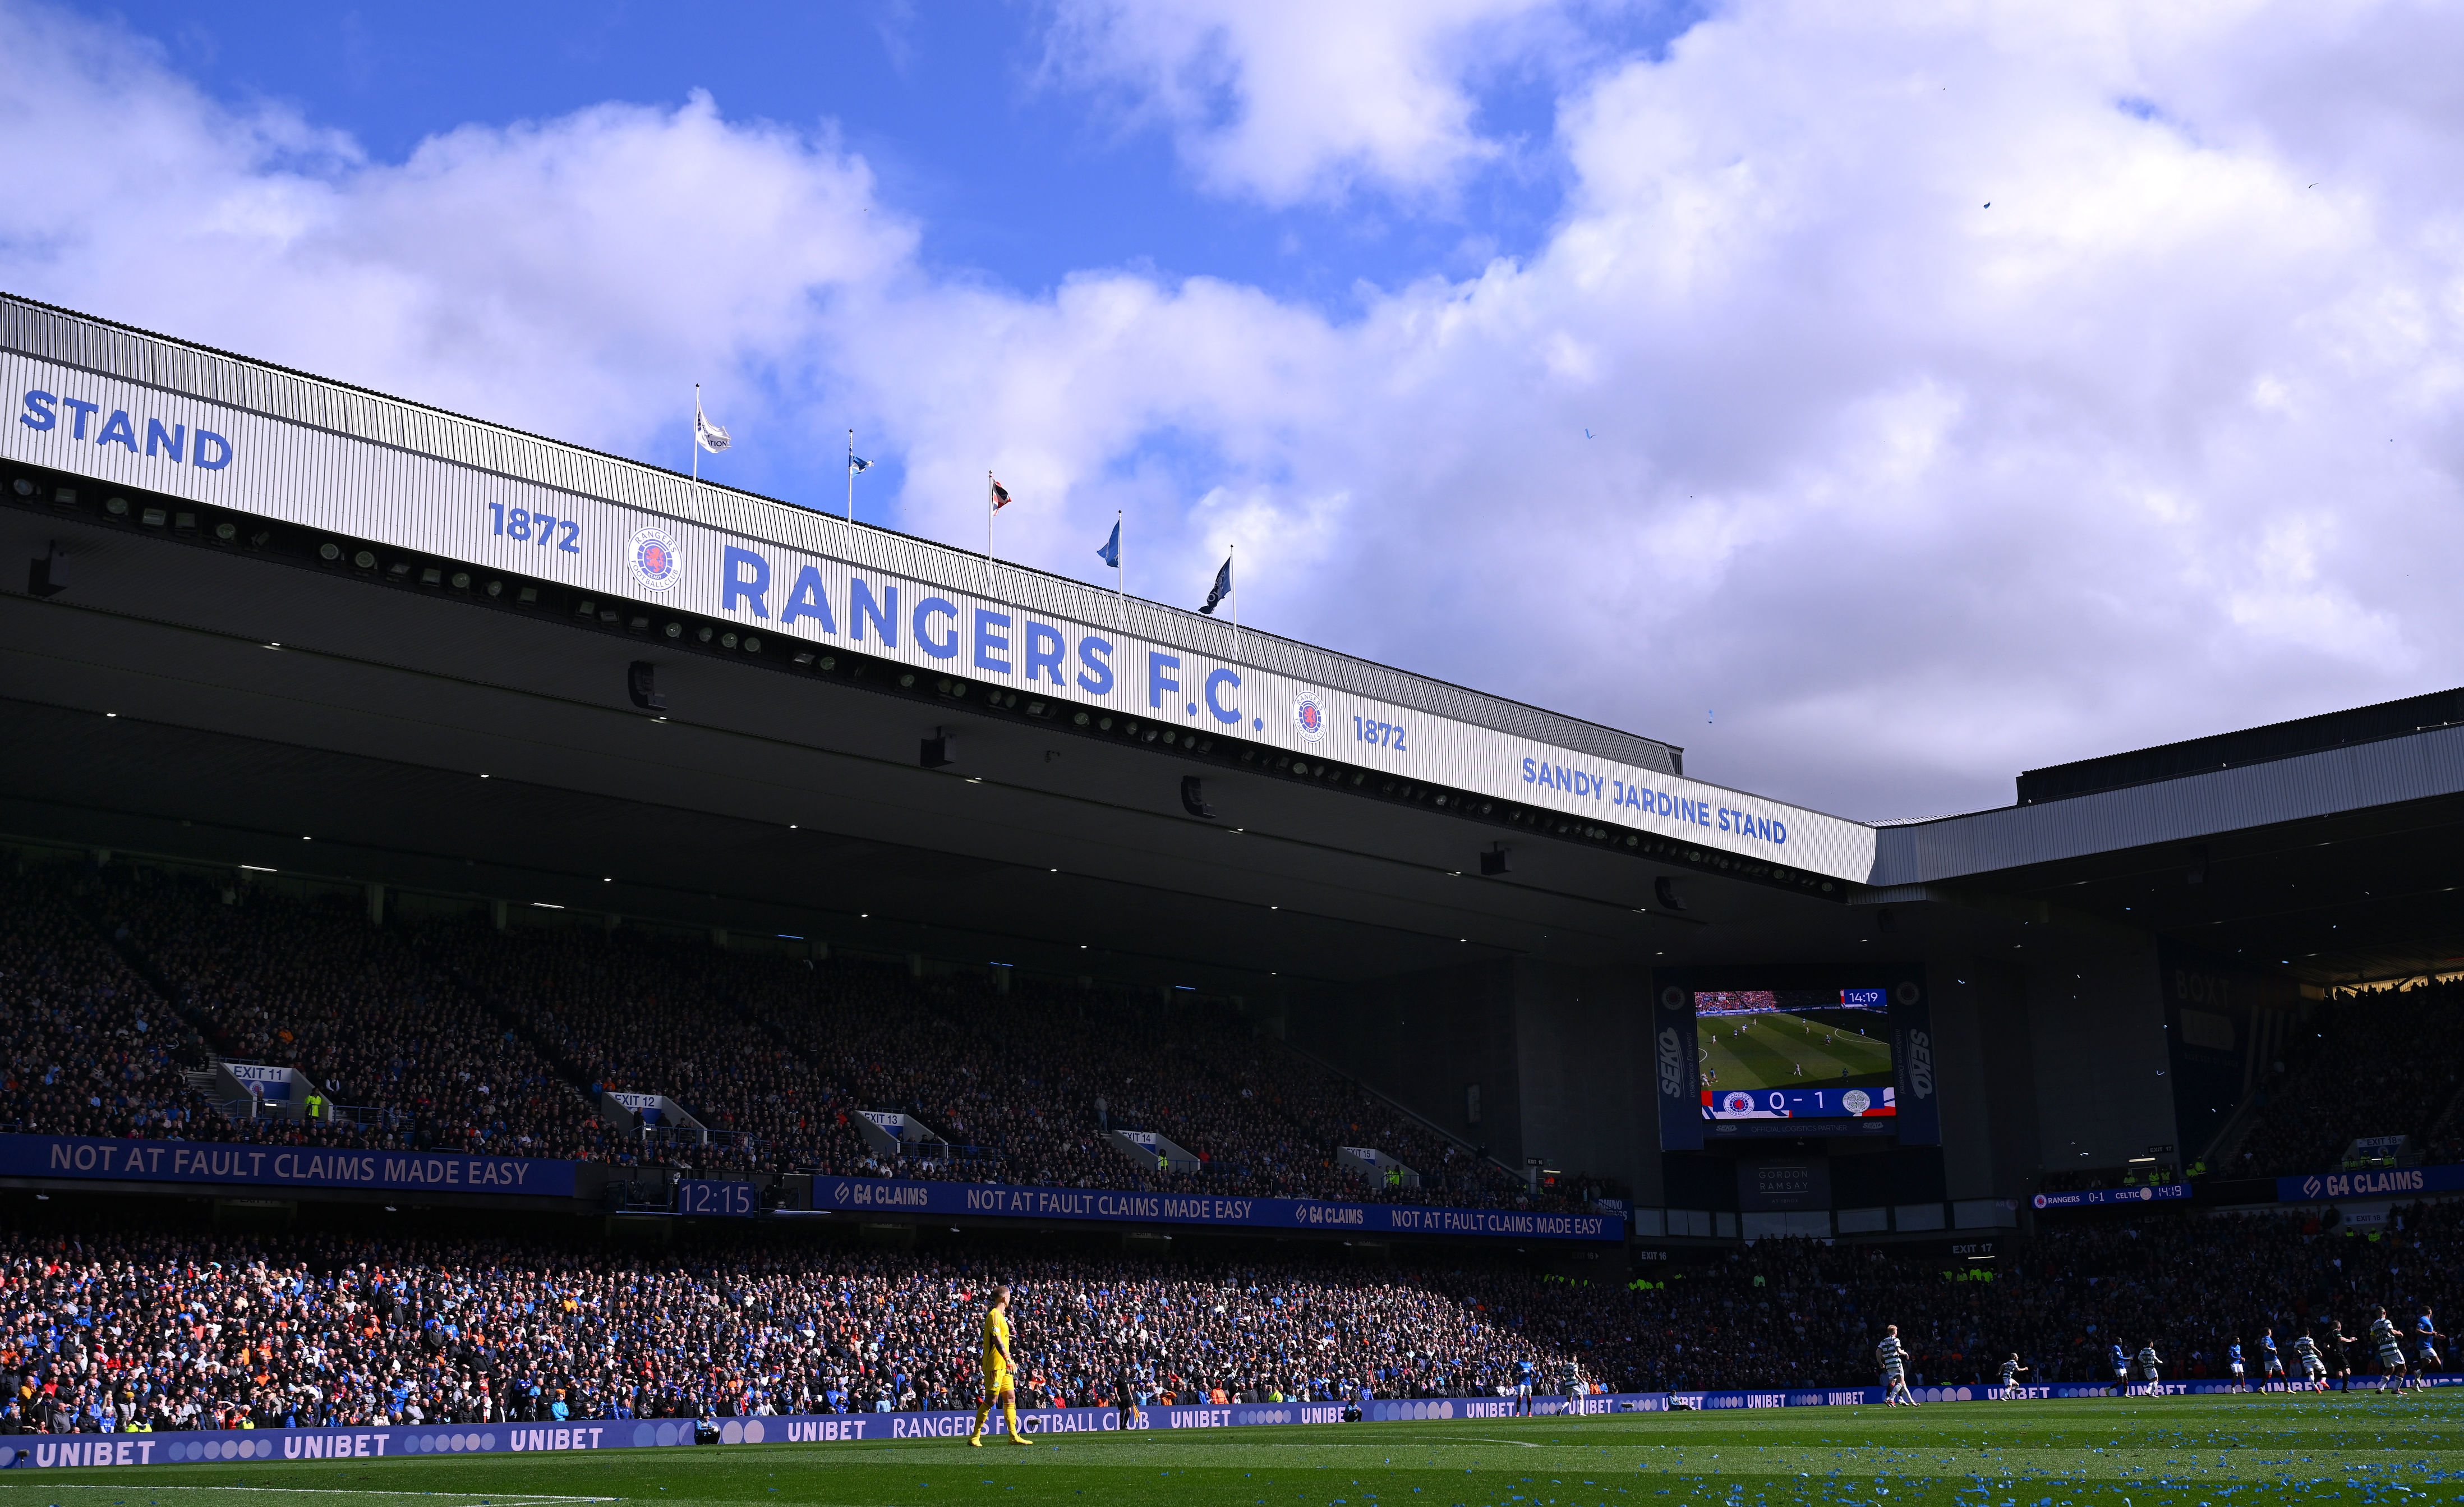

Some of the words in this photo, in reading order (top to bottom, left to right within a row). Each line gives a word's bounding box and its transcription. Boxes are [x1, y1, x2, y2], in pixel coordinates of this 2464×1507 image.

[20, 390, 233, 470] STAND
[489, 502, 580, 554] 1872
[635, 531, 677, 553] RANGERS
[631, 560, 664, 587] FOOTBALL
[665, 569, 678, 585] CLUB
[722, 545, 1112, 695] RANGERS
[1149, 651, 1263, 731] F.C.
[1297, 694, 1323, 711] RANGERS
[1295, 718, 1316, 739] FOOTBALL
[1316, 724, 1325, 737] CLUB
[1353, 716, 1406, 751] 1872
[1523, 757, 1604, 800] SANDY
[1613, 780, 1710, 827] JARDINE
[1718, 807, 1786, 844] STAND
[1850, 992, 1878, 1002] 14:19
[234, 1065, 265, 1079] EXIT
[269, 1069, 282, 1080] 11
[1659, 1027, 1681, 1098] SEKO
[1910, 1028, 1933, 1099] SEKO
[615, 1094, 639, 1105] EXIT
[643, 1096, 655, 1107] 12
[1770, 1092, 1784, 1109] 0
[1814, 1091, 1823, 1109] 1
[887, 1115, 897, 1124] 13
[1122, 1132, 1140, 1142] XIT
[1142, 1134, 1150, 1142] 14
[1347, 1148, 1361, 1157] XIT
[50, 1143, 117, 1171] NOT
[125, 1147, 165, 1173] AT
[174, 1149, 266, 1177] FAULT
[274, 1154, 375, 1181] CLAIMS
[384, 1158, 459, 1183] MADE
[468, 1161, 529, 1185] EASY
[1760, 1182, 1808, 1190] RAMSAY
[2327, 1175, 2350, 1196] G4
[2354, 1170, 2424, 1193] CLAIMS
[682, 1184, 749, 1213] 12:15
[854, 1184, 872, 1205] G4
[875, 1186, 928, 1206] CLAIMS
[968, 1189, 1006, 1210] NOT
[1010, 1192, 1034, 1211] AT
[1039, 1193, 1094, 1214] FAULT
[1098, 1196, 1159, 1217] CLAIMS
[1164, 1198, 1210, 1218] MADE
[1215, 1201, 1252, 1219] EASY
[2048, 1196, 2080, 1204] RANGERS
[2089, 1192, 2104, 1202] 0-1
[2158, 1186, 2182, 1197] 14:19
[1310, 1206, 1323, 1224] G4
[1325, 1207, 1364, 1224] CLAIMS
[1392, 1210, 1420, 1228] NOT
[1424, 1211, 1441, 1228] AT
[1444, 1212, 1485, 1230] FAULT
[1488, 1215, 1533, 1233] CLAIMS
[1537, 1217, 1572, 1234] MADE
[1574, 1218, 1602, 1234] EASY
[1641, 1251, 1657, 1260] EXIT
[1659, 1252, 1667, 1260] 16
[1952, 1244, 1977, 1254] EXIT
[1981, 1243, 1992, 1252] 17
[1829, 1391, 1864, 1406] UNIBET
[2127, 1384, 2187, 1396] UNBET
[1466, 1402, 1515, 1418] UNIBET
[1662, 1394, 1703, 1412] UBET
[1747, 1394, 1786, 1409] UNIBET
[1171, 1409, 1231, 1428] UNIBET
[1301, 1407, 1346, 1424] UNIBE
[510, 1428, 603, 1451] UNIBET
[787, 1420, 866, 1442] UNIBET
[36, 1440, 156, 1467] UNIBET
[284, 1434, 390, 1459] UNIBET
